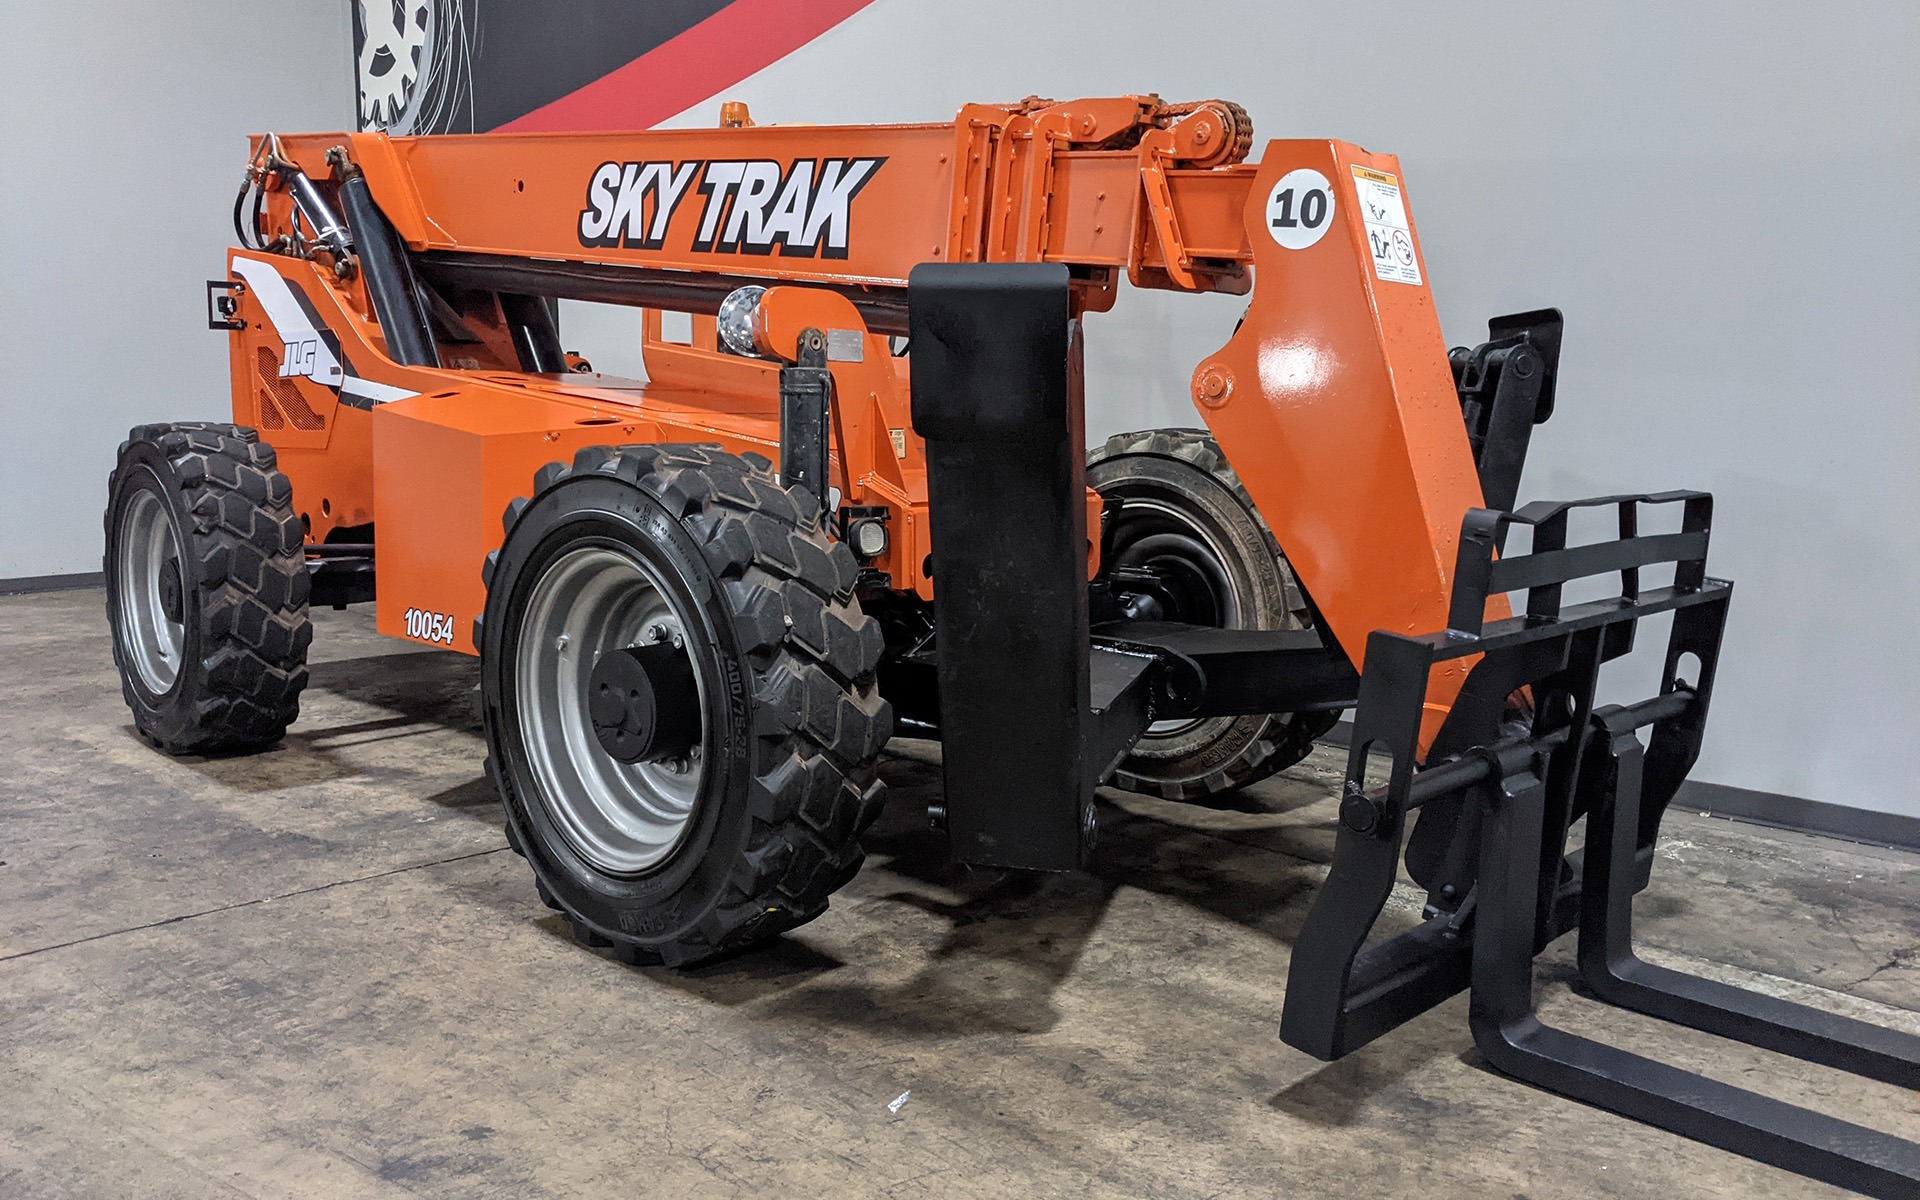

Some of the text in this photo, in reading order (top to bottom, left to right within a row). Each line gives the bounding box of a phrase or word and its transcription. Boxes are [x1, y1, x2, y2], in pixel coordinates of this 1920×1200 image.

[579, 157, 888, 259] SKY TRAK
[1272, 188, 1328, 230] 10
[278, 340, 317, 378] JLG
[404, 607, 454, 645] 10054
